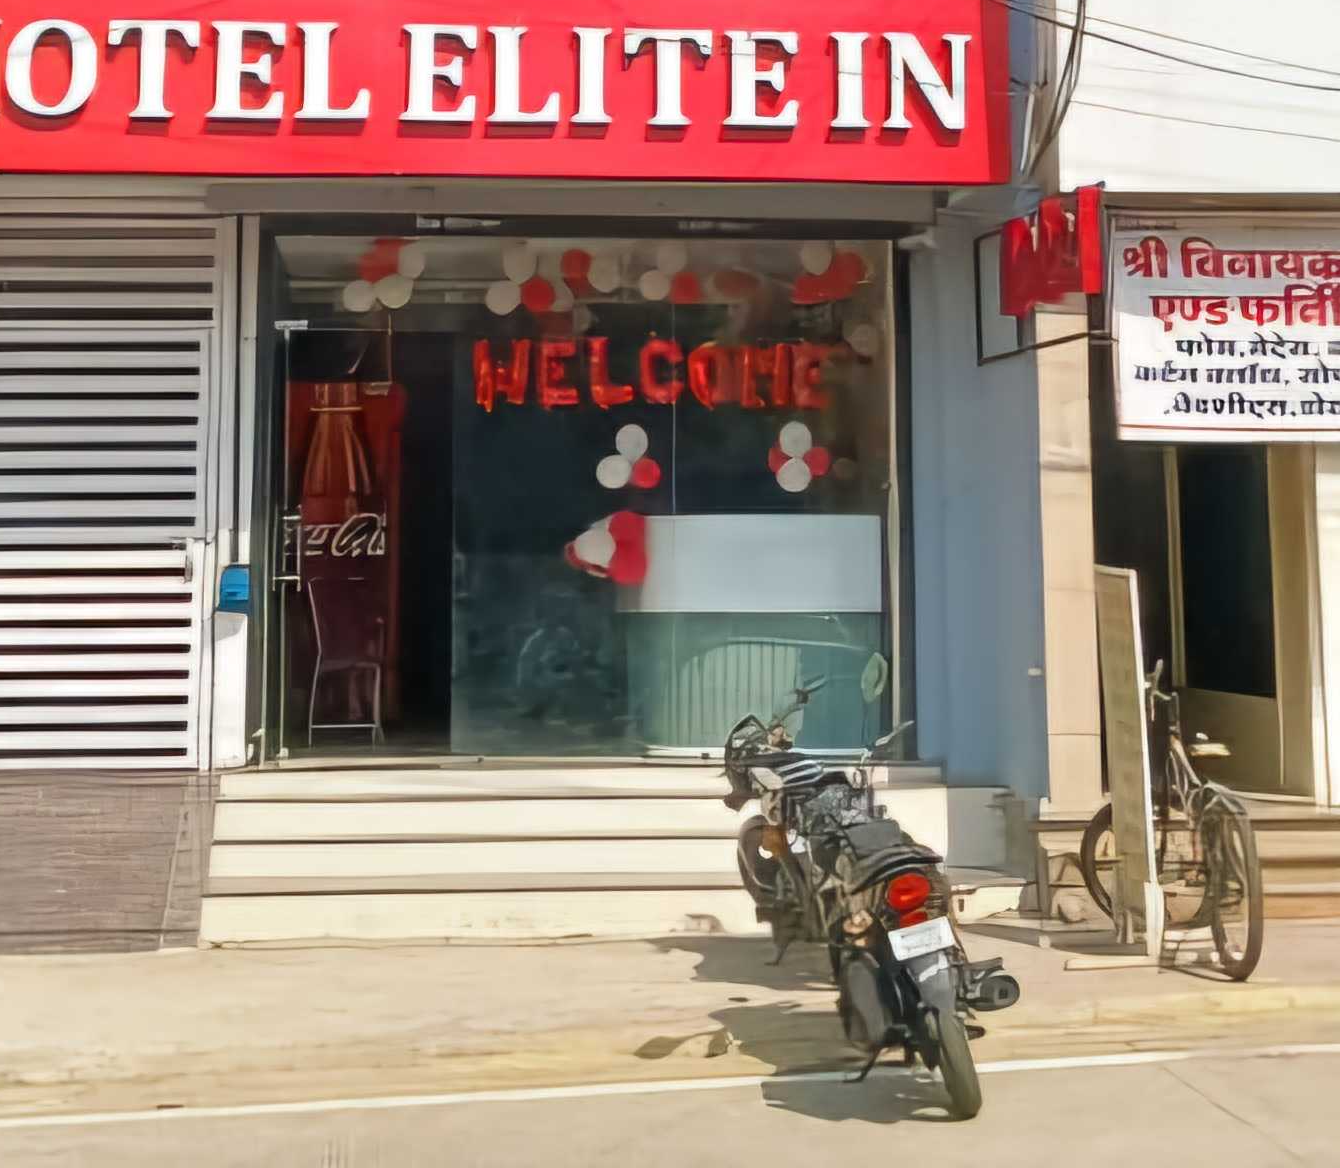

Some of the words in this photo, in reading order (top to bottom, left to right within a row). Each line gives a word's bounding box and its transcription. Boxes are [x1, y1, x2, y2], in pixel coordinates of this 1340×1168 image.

[399, 23, 799, 127] ELITE
[830, 31, 972, 131] IN
[1123, 235, 1168, 278] श्री
[472, 334, 832, 412] WELCOME
